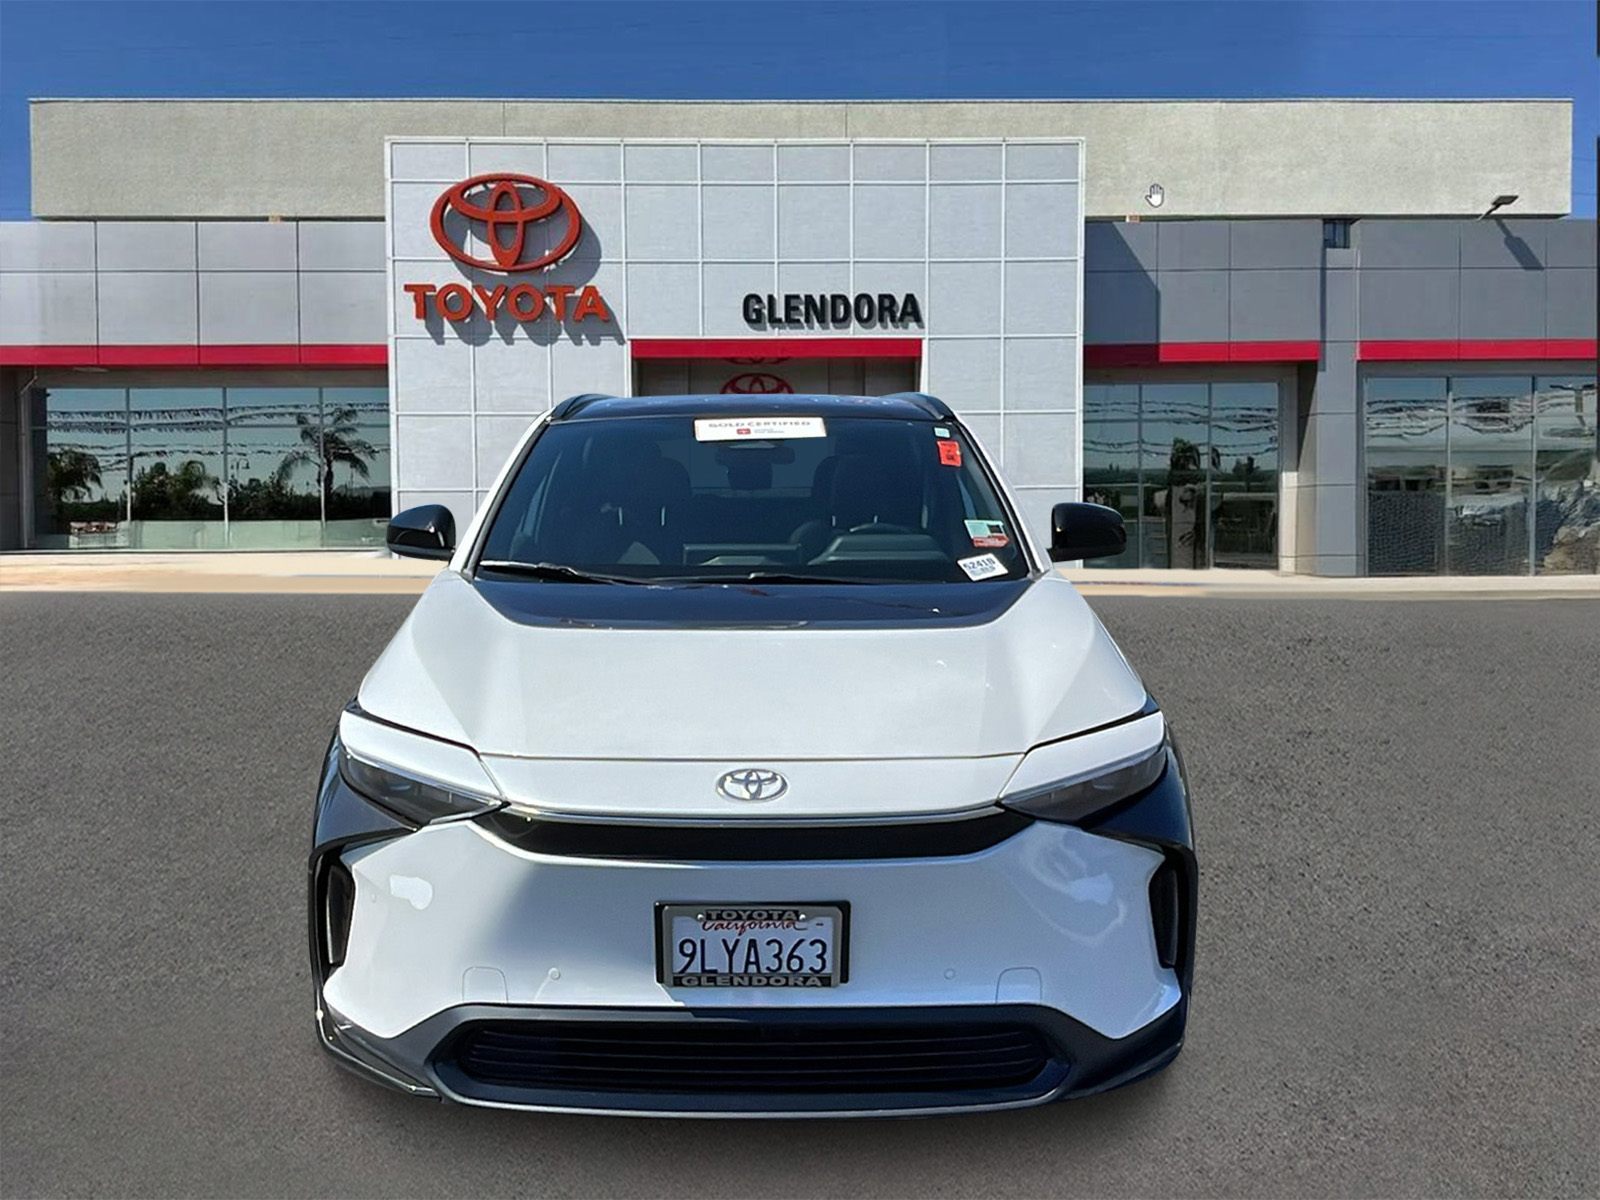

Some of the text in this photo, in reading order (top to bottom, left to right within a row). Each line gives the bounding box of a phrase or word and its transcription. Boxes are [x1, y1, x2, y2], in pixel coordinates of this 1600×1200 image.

[404, 283, 610, 322] TOYOTA
[743, 293, 923, 325] GLENDORA
[706, 910, 798, 920] TOYOTA
[702, 919, 808, 936] California
[678, 938, 828, 974] 9LYA363
[681, 975, 822, 987] GLENDORA
